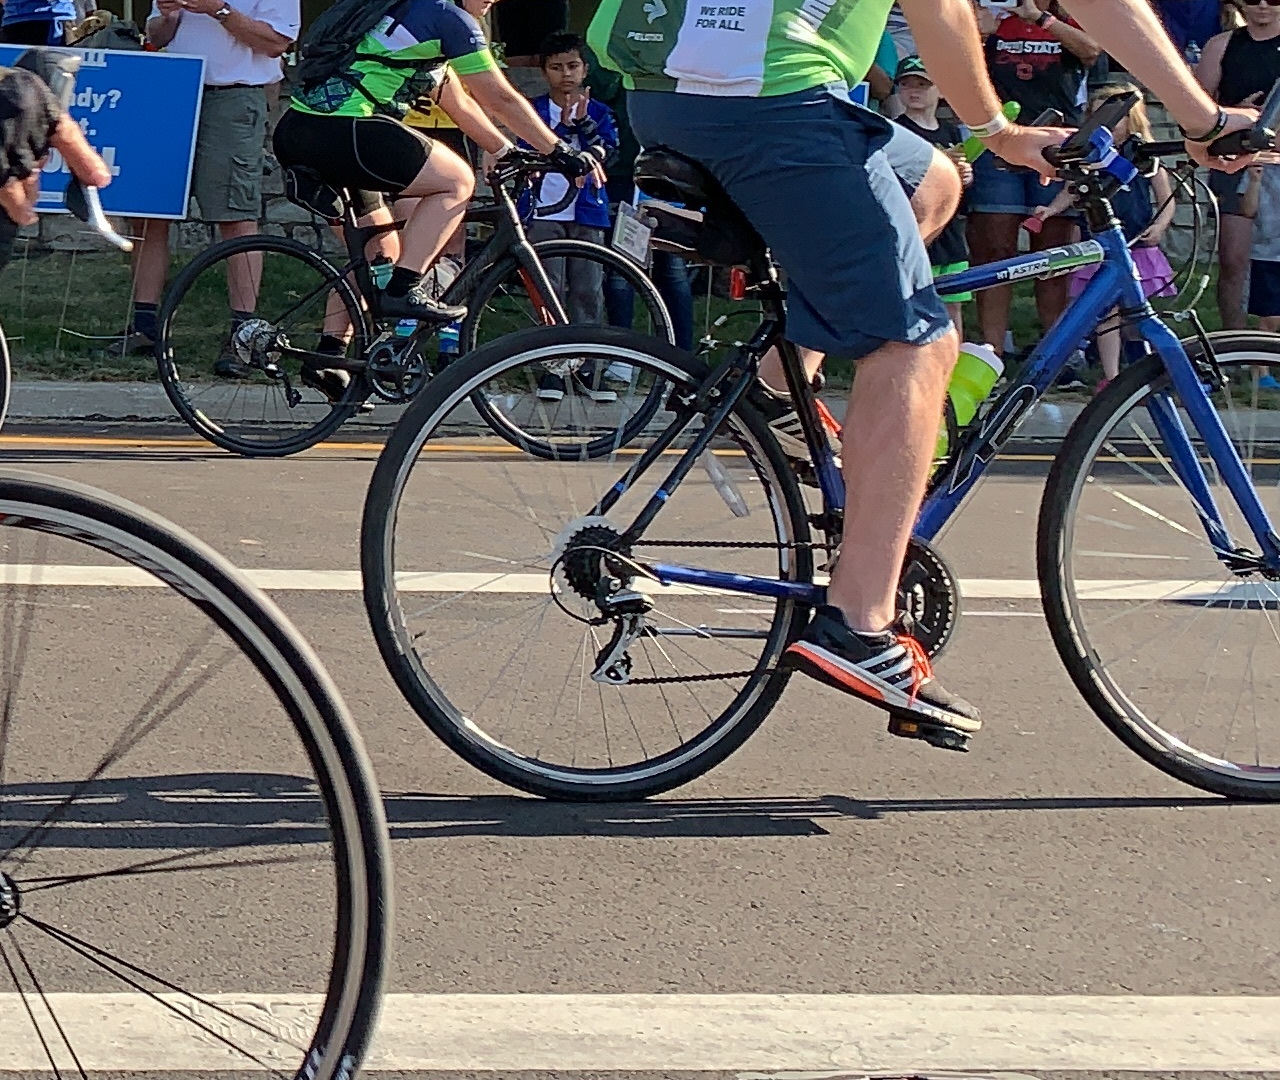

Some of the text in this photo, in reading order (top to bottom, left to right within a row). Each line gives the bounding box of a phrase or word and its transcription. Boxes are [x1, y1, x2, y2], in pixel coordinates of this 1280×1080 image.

[699, 5, 746, 18] WE RIDE
[694, 18, 716, 30] FOR
[1023, 41, 1063, 54] STATE
[1012, 260, 1051, 277] ASTRA
